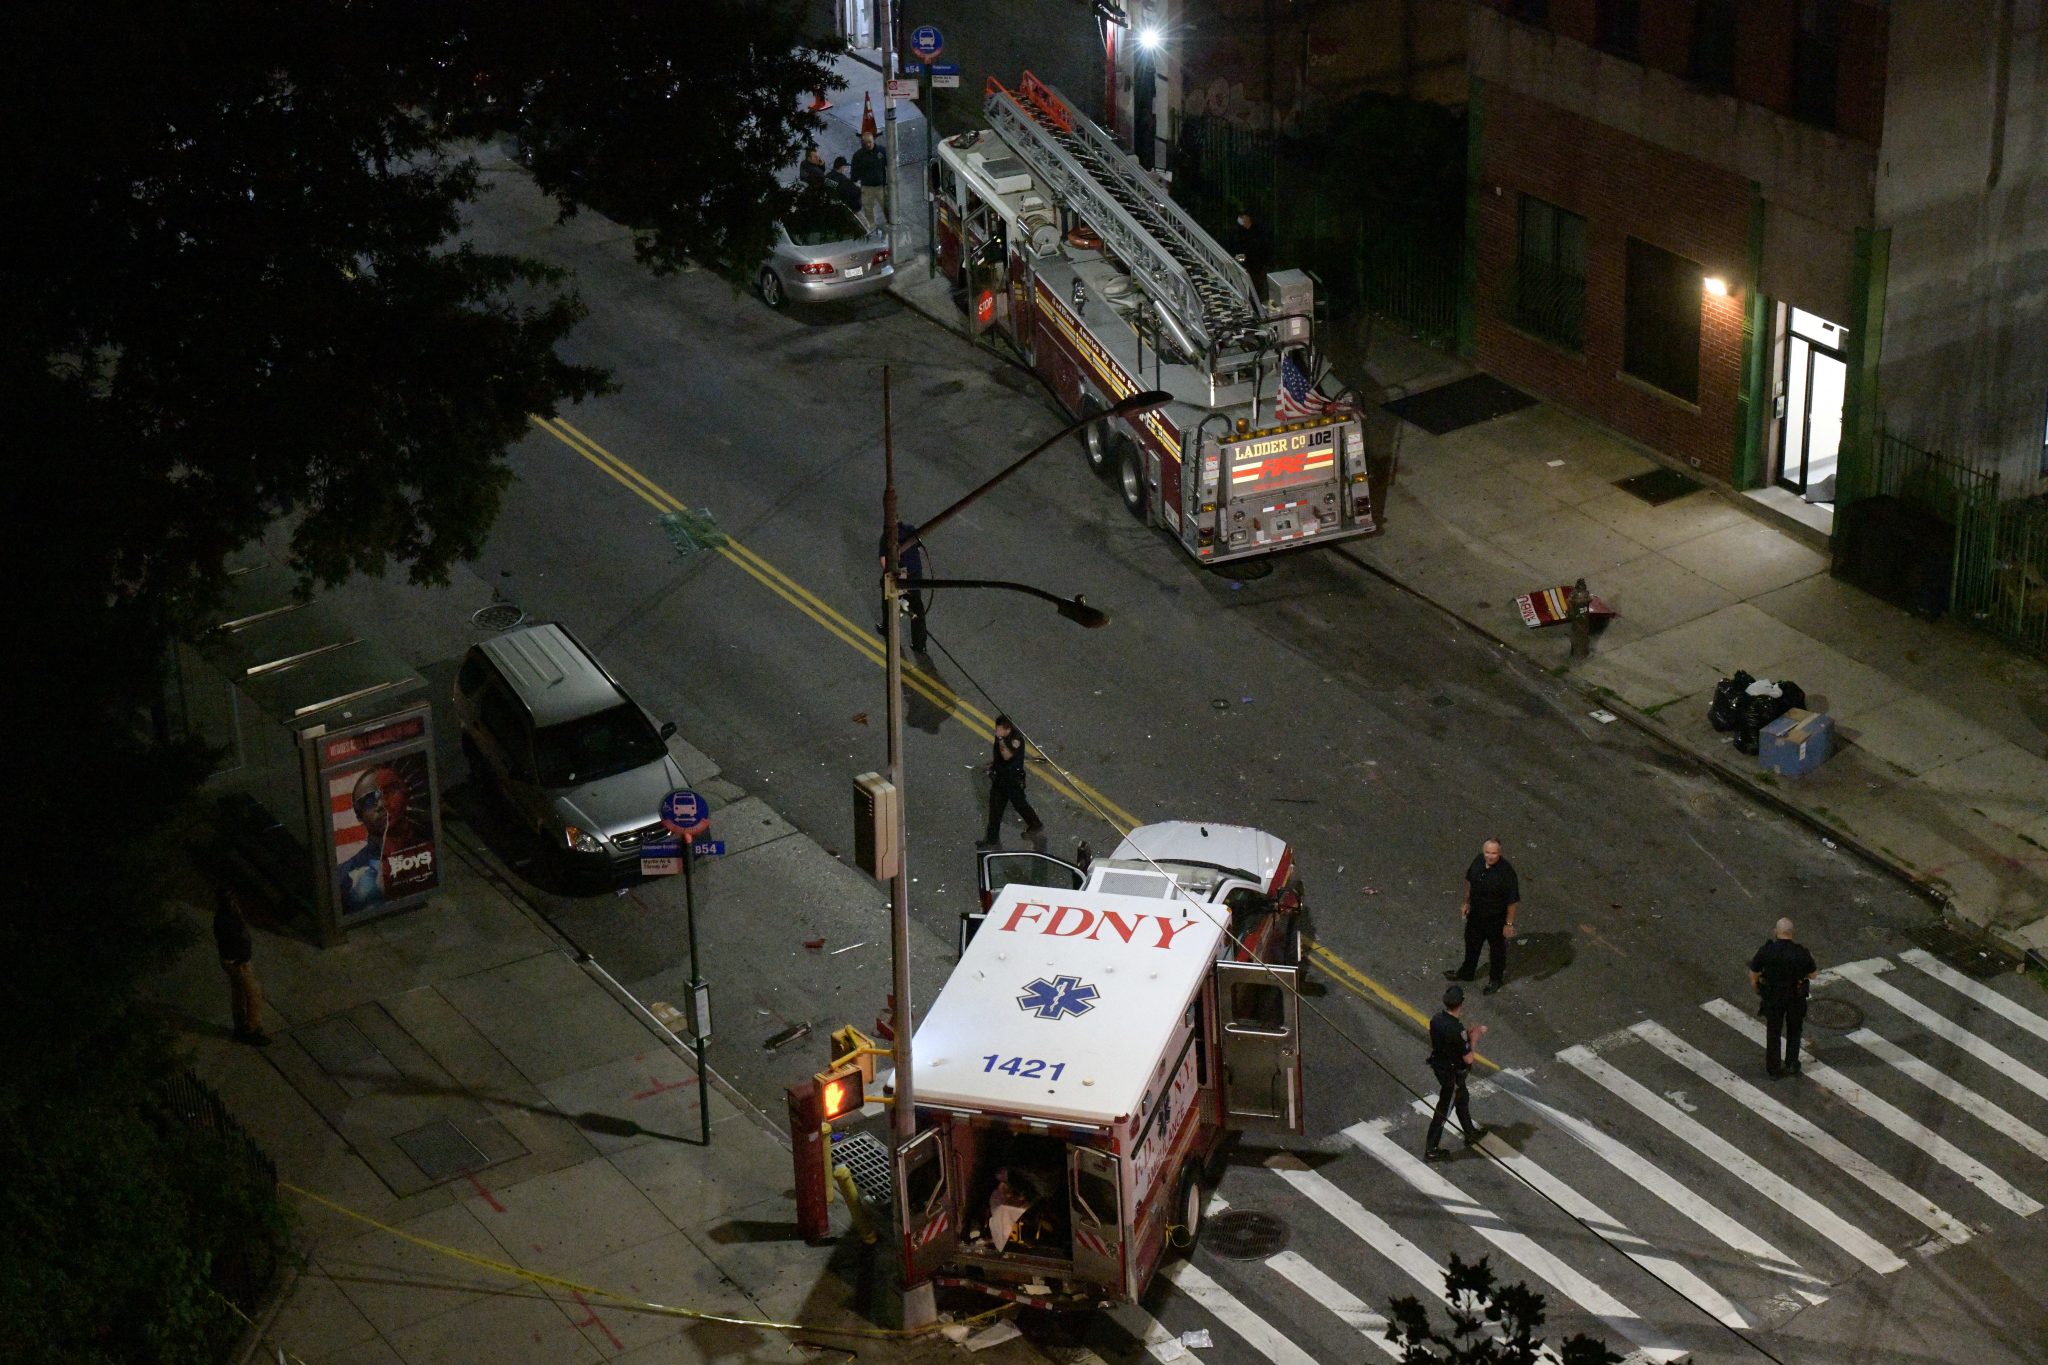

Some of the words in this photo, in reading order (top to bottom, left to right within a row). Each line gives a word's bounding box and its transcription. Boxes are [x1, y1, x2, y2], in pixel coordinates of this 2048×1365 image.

[978, 296, 993, 315] STOP
[1234, 438, 1288, 461] LADDER
[1307, 430, 1332, 447] 102
[1258, 453, 1307, 479] FIRE
[695, 843, 717, 854] B54
[390, 851, 432, 878] BOYS
[998, 902, 1199, 950] FDNY
[982, 1054, 1066, 1081] 1421
